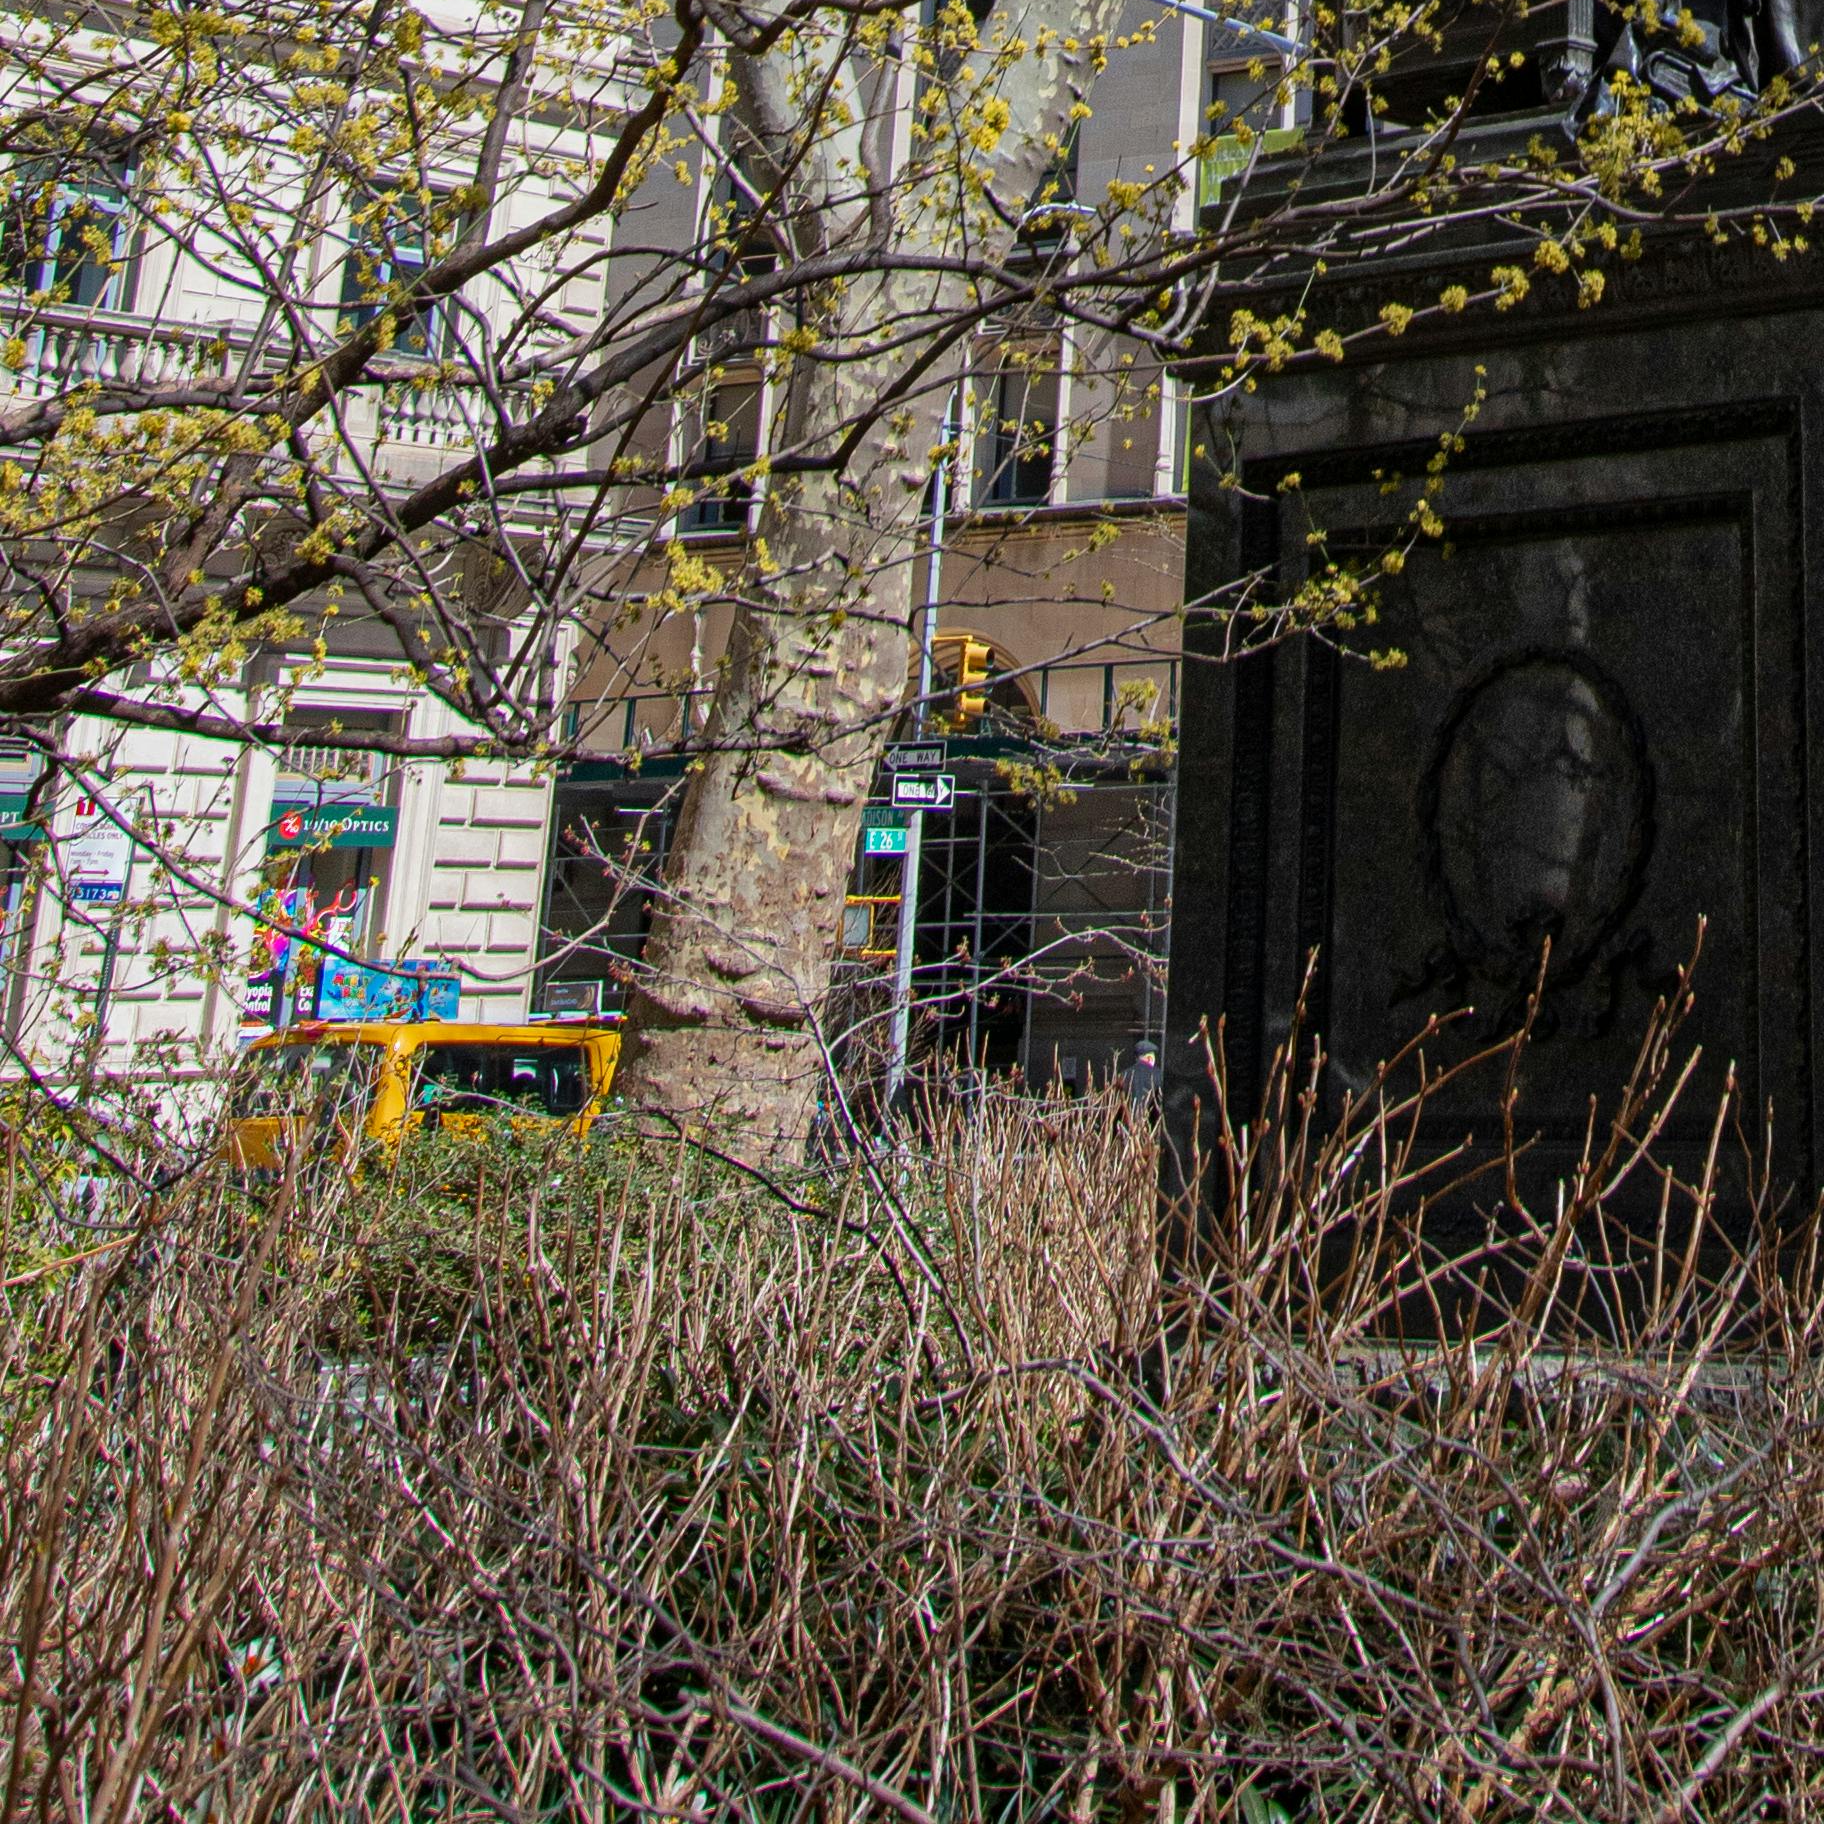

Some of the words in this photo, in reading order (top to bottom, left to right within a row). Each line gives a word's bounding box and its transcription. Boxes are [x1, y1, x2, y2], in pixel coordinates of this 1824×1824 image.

[889, 752, 908, 764] ONE
[916, 751, 937, 763] WAY
[862, 810, 893, 826] ADISON
[869, 831, 876, 849] E
[880, 831, 893, 849] 26
